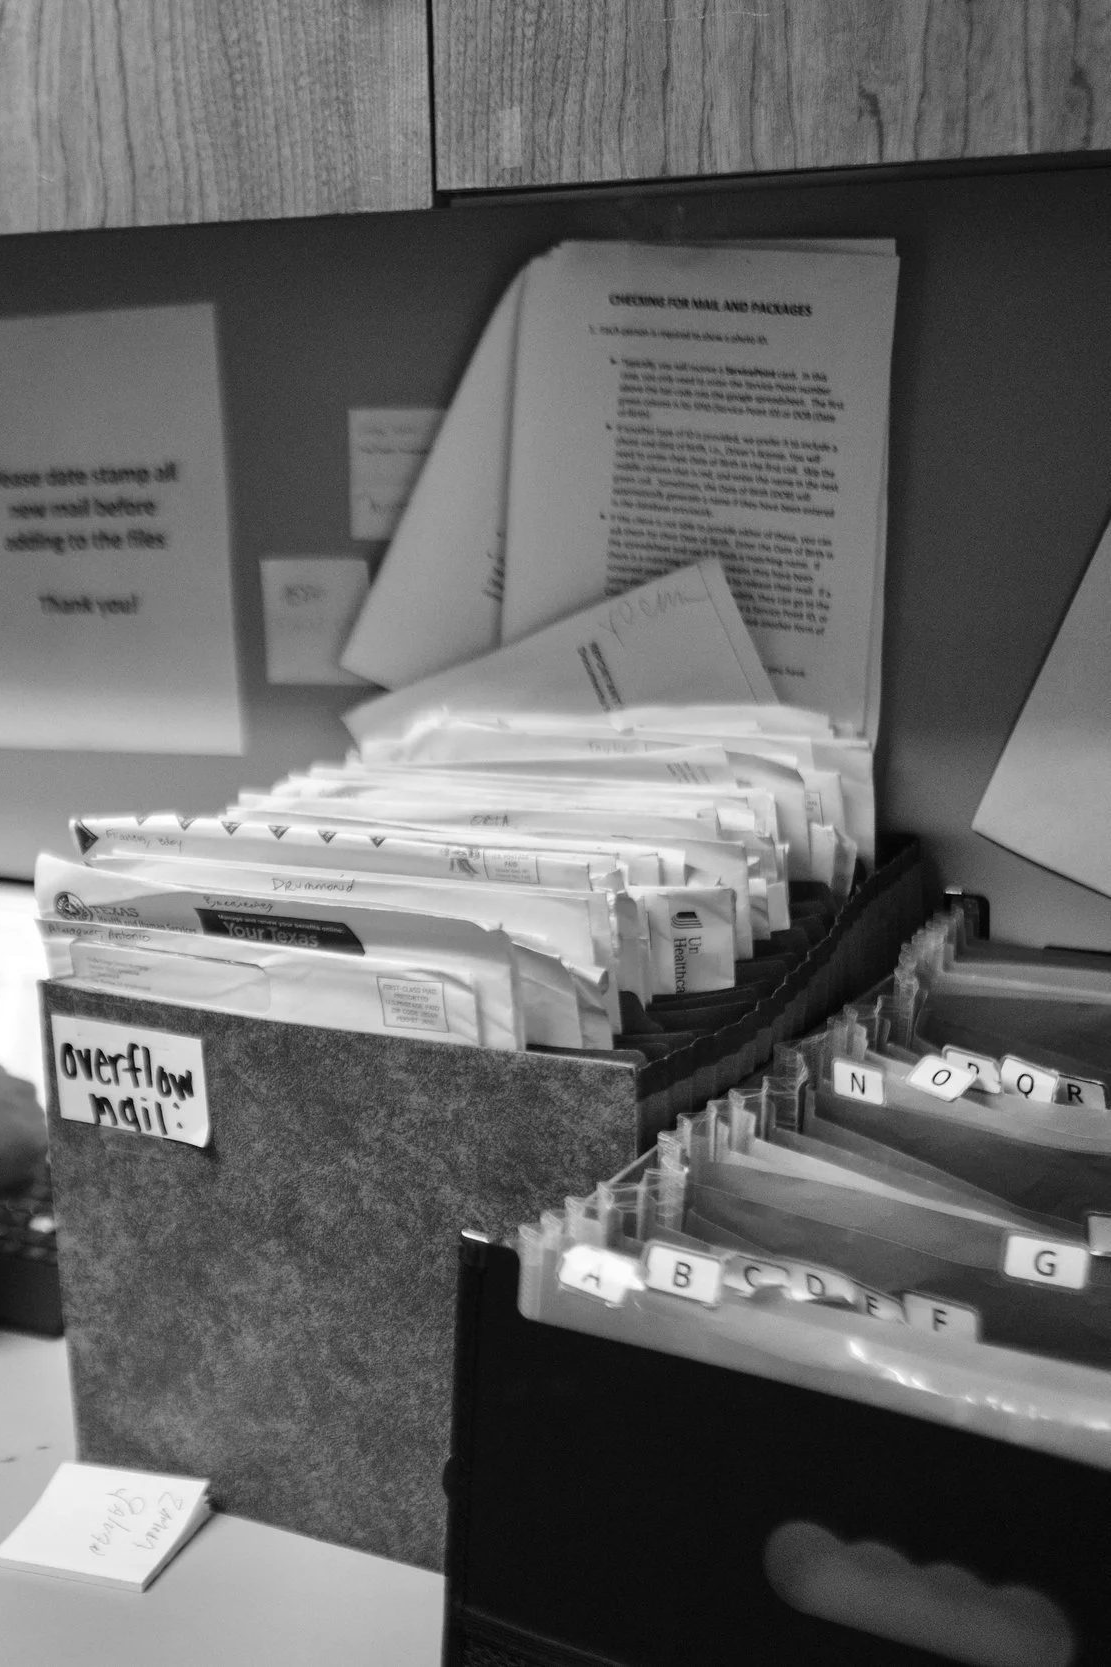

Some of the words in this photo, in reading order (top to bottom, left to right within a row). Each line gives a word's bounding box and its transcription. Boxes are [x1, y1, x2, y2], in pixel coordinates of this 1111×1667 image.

[724, 300, 747, 312] AND
[751, 301, 812, 316] PACKAGES
[154, 462, 179, 483] all
[51, 498, 90, 518] mail
[93, 496, 158, 517] before
[67, 533, 87, 550] to
[91, 530, 123, 550] the
[38, 589, 93, 614] Thank
[90, 906, 139, 918] TEXAS
[222, 921, 264, 941] Your
[268, 926, 318, 948] Texas
[673, 937, 686, 993] Healthca
[851, 1072, 866, 1095] N
[932, 1069, 951, 1086] O
[1016, 1073, 1035, 1098] Q
[1067, 1084, 1084, 1104] R
[673, 1262, 692, 1288] B
[1034, 1251, 1056, 1277] G
[581, 1263, 602, 1289] A
[744, 1266, 761, 1288] C
[806, 1272, 825, 1296] D
[867, 1295, 879, 1316] E
[932, 1307, 948, 1331] F
